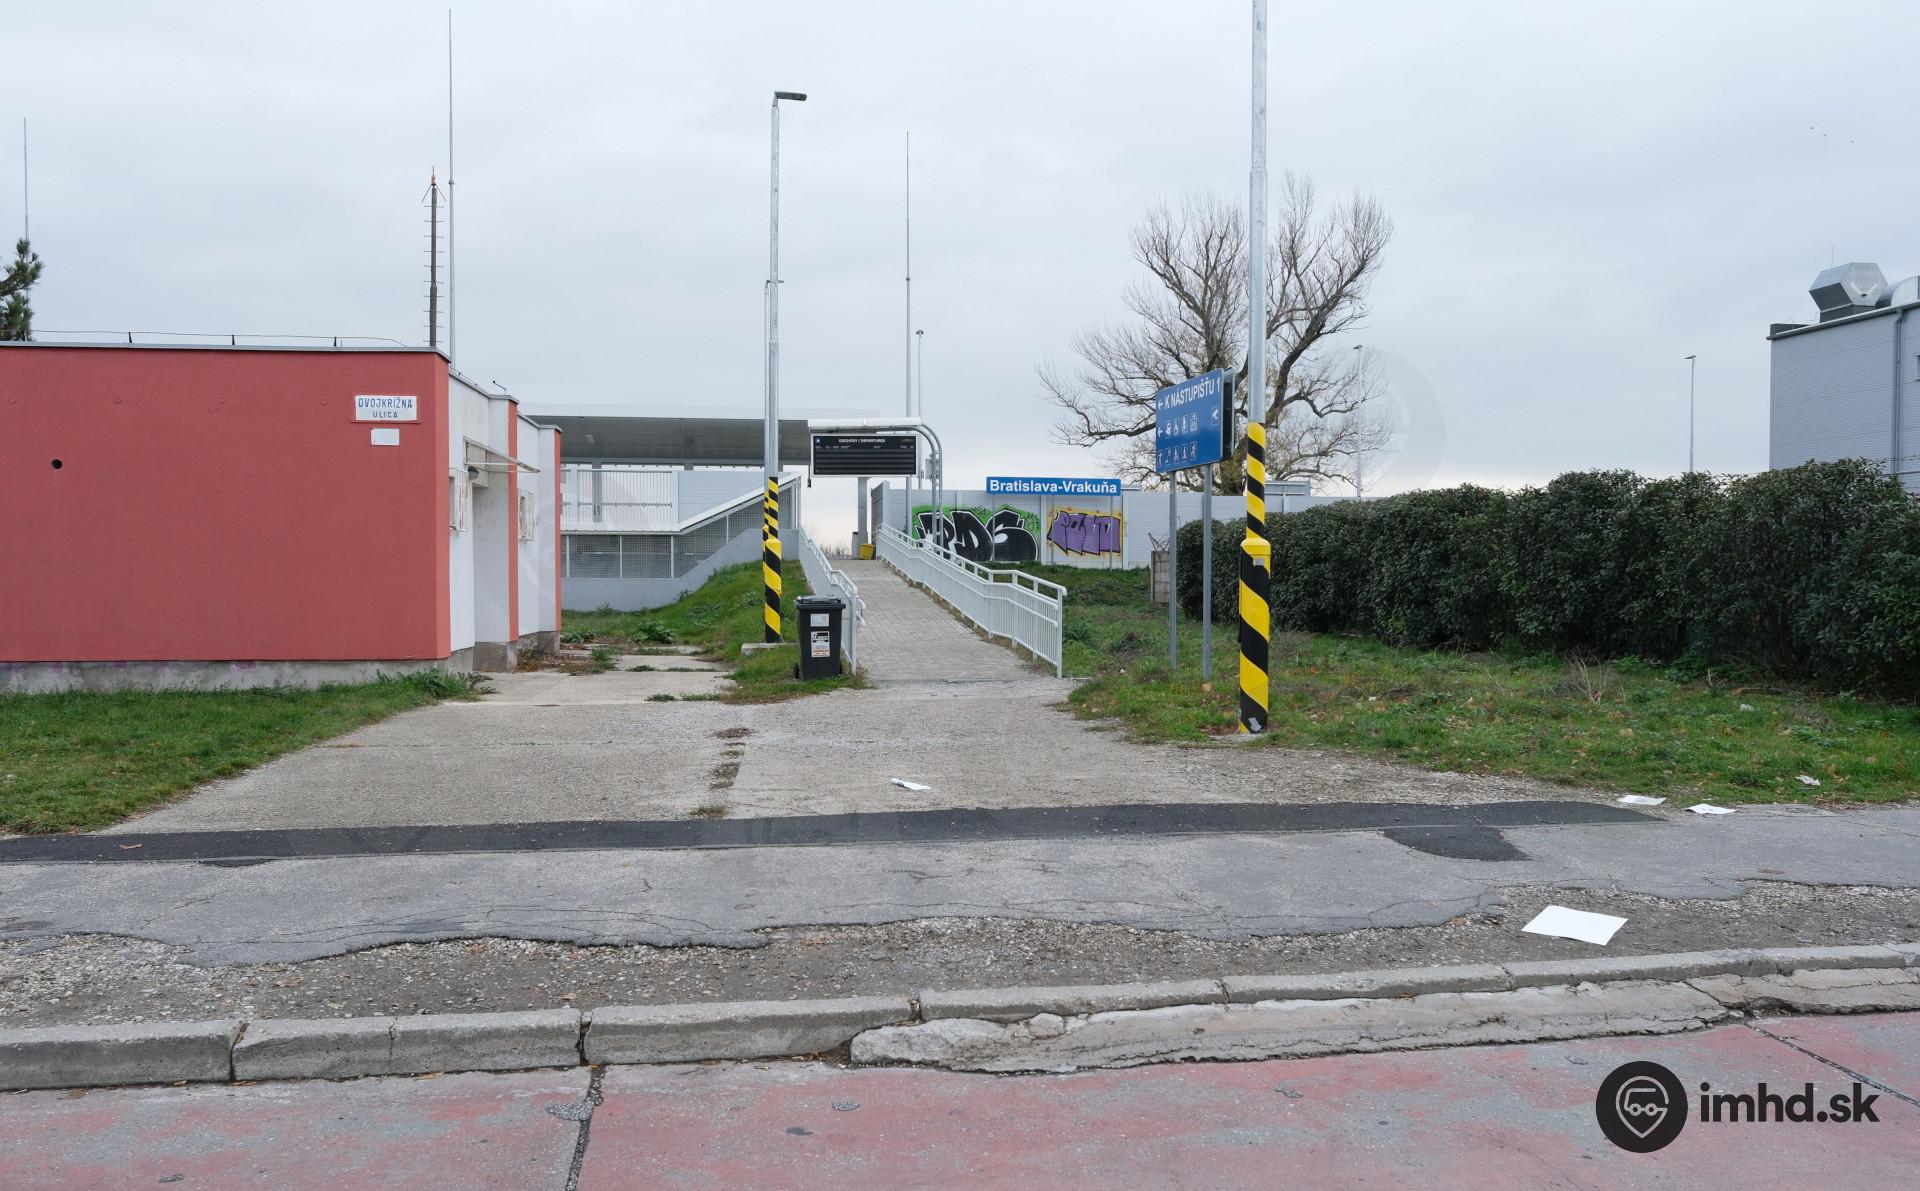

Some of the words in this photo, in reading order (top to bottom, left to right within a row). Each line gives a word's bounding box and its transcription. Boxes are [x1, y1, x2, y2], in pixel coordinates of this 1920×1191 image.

[1164, 394, 1170, 410] K
[1171, 377, 1215, 408] NÁSTUPIŠŤU
[1216, 377, 1221, 393] 1
[989, 479, 1117, 494] Bratislava-Vrakuňa
